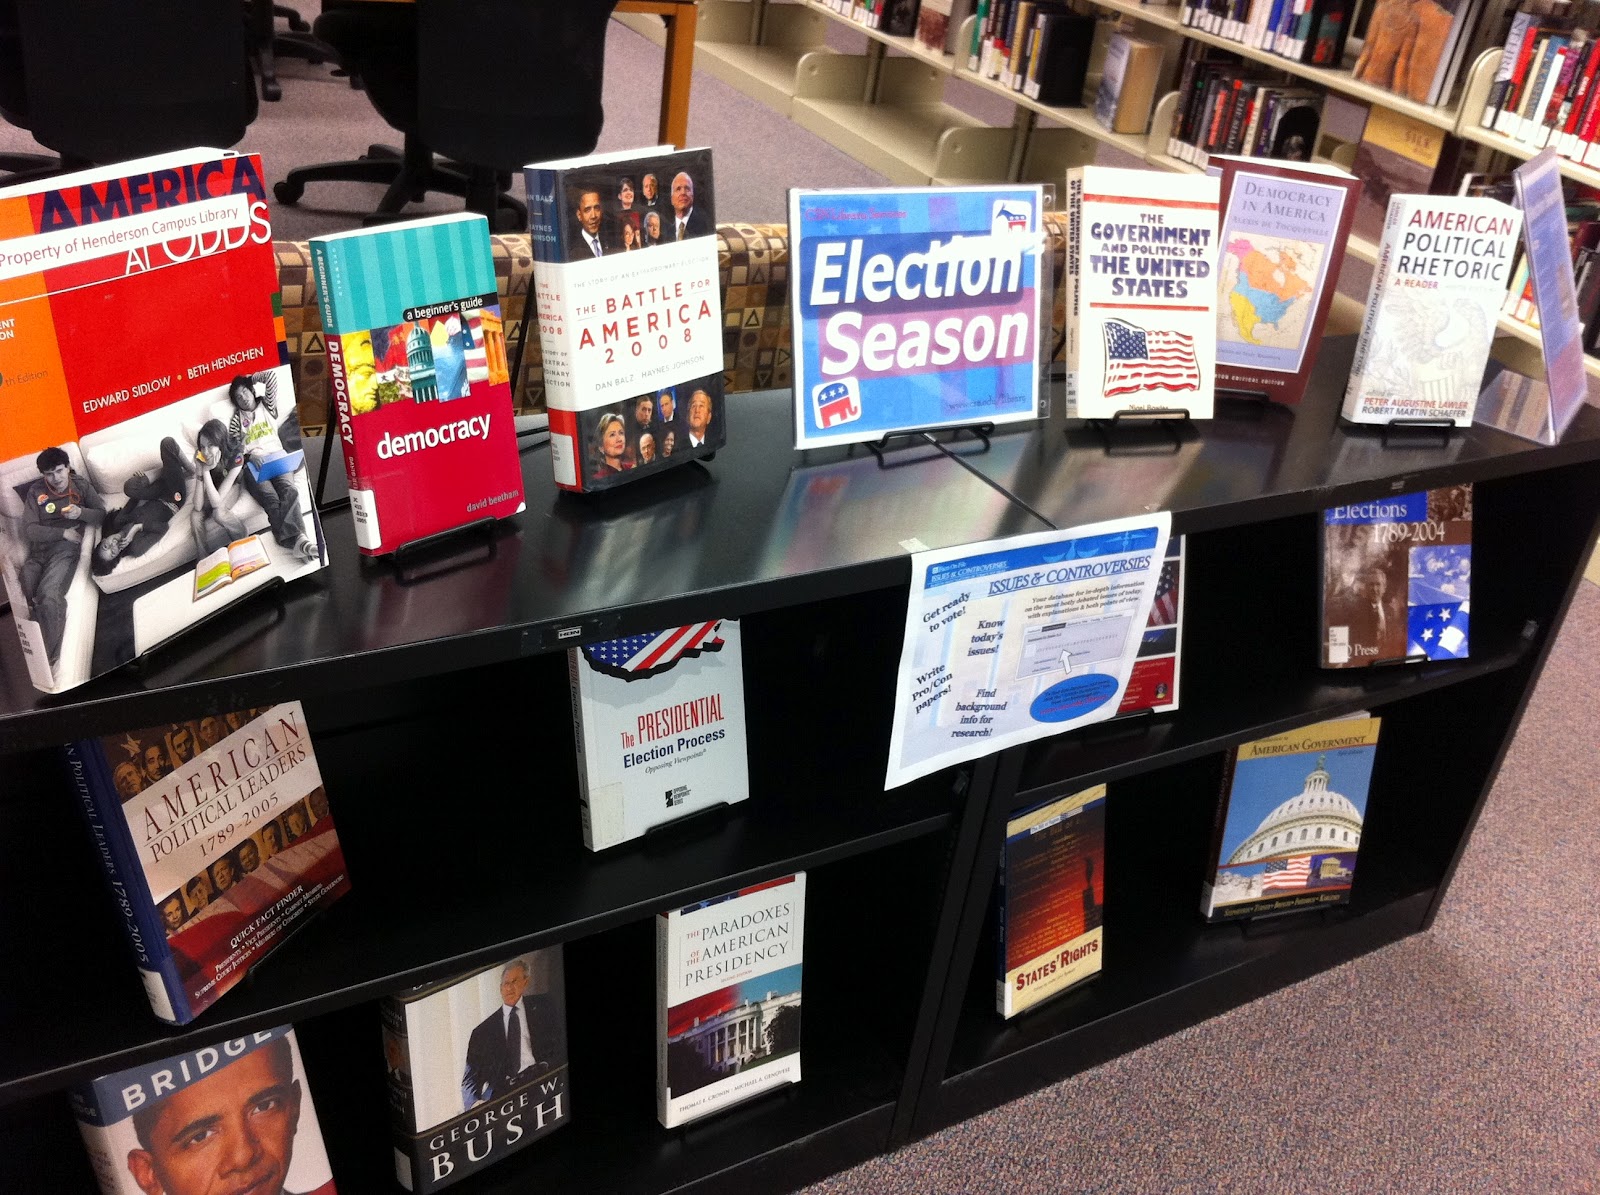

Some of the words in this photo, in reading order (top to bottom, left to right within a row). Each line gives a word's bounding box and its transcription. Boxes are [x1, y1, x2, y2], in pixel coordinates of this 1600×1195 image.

[39, 155, 266, 234] AMERICA
[1244, 182, 1333, 207] DEMOCRACY
[1140, 213, 1164, 225] THE
[1242, 200, 1257, 211] IN
[1261, 201, 1326, 222] AMERICA
[1408, 209, 1513, 236] AMERICAN
[65, 237, 78, 254] of
[82, 227, 149, 251] Henderson
[152, 216, 197, 236] Campus
[199, 206, 239, 224] Library
[1090, 222, 1211, 247] GOVERNMENT
[1101, 243, 1128, 254] AND
[1131, 244, 1186, 257] POLITICS
[1189, 247, 1203, 258] OF
[1402, 232, 1507, 259] POLITICAL
[809, 238, 1022, 306] Election
[1089, 254, 1130, 276] THE
[1136, 256, 1210, 278] UNITED
[1397, 255, 1504, 281] RHETORIC
[575, 304, 597, 317] THE
[606, 282, 684, 314] BATTLE
[690, 279, 710, 290] FOR
[1111, 277, 1188, 299] STATES
[1394, 279, 1401, 287] A
[1403, 280, 1439, 290] READER
[324, 303, 335, 329] GUIDE
[406, 311, 414, 320] a
[415, 300, 459, 321] beginner's
[460, 297, 483, 314] guide
[578, 299, 712, 350] AMERICA
[604, 328, 692, 365] 2008
[821, 311, 1029, 376] Season
[187, 363, 210, 379] BETH
[211, 347, 264, 371] HENSCHEN
[595, 379, 614, 391] DAN
[615, 375, 635, 388] BALZ
[641, 364, 670, 379] HAYNES
[672, 354, 705, 373] JOHNSON
[17, 370, 48, 384] Edition
[83, 391, 130, 414] EDWARD
[131, 376, 171, 400] SIDLOW
[328, 341, 354, 445] DEMOCRACY
[1364, 397, 1389, 406] PETER
[1391, 399, 1437, 409] AUGUSTINE
[1438, 401, 1468, 410] LAWLER
[1361, 406, 1394, 415] ROBERT
[1396, 407, 1427, 417] MARTIN
[1428, 409, 1467, 418] SCHAEFER
[376, 413, 492, 461] democracy
[466, 498, 488, 514] david
[488, 488, 519, 509] beetham
[1334, 500, 1408, 519] Elections
[1373, 521, 1446, 544] 1789-2004
[988, 575, 1031, 595] ISSUES
[1030, 571, 1046, 586] &
[1046, 555, 1152, 583] CONTROVERSIES
[1032, 596, 1047, 604] Your
[1048, 592, 1075, 601] database
[1085, 585, 1110, 595] in-depth
[1110, 581, 1145, 591] information
[1033, 603, 1044, 611] the
[1044, 602, 1060, 610] most
[1060, 599, 1075, 608] hotly
[1076, 595, 1099, 604] debated
[1099, 592, 1117, 600] issues
[922, 607, 941, 623] Get
[942, 592, 971, 612] ready
[929, 623, 940, 633] to
[941, 605, 967, 625] vote!
[1027, 612, 1041, 620] with
[1041, 606, 1080, 618] explanations
[1086, 601, 1099, 610] both
[1100, 599, 1119, 609] points
[559, 628, 581, 638] HON
[970, 631, 1003, 644] today's
[977, 619, 1005, 630] Know
[967, 644, 1000, 657] issues!
[1354, 644, 1379, 657] Press
[911, 673, 953, 703] Pro/Con
[916, 664, 946, 685] Write
[915, 684, 952, 715] papers!
[976, 688, 998, 698] Find
[955, 701, 1008, 713] background
[959, 714, 979, 725] info
[978, 714, 994, 724] for
[620, 732, 635, 750] The
[636, 693, 725, 745] PRESIDENTIAL
[951, 727, 993, 738] research!
[623, 743, 674, 769] Election
[677, 728, 726, 754] Process
[1249, 742, 1300, 757] AMERICAN
[1302, 735, 1367, 750] GOVERNMENT
[144, 710, 302, 841] AMERICAN
[645, 761, 673, 774] Opposing
[150, 799, 238, 863] POLITICAL
[240, 743, 308, 809] LEADERS
[200, 792, 279, 857] 1789-2005
[69, 760, 98, 820] POLITICAL
[91, 823, 117, 875] LEADERS
[112, 879, 150, 963] 1789-2005
[230, 921, 256, 949] QUICK
[255, 906, 276, 928] FACT
[276, 885, 304, 911] FINDER
[686, 930, 700, 940] THE
[701, 902, 791, 942] PARADOXES
[194, 977, 217, 999] SUPREME
[215, 963, 233, 982] COURT
[231, 949, 253, 970] JUSTICES
[255, 929, 277, 951] MEMBERS
[307, 894, 321, 910] STATE
[215, 948, 242, 973] PRESIDENTS
[244, 936, 258, 948] VICE
[256, 916, 281, 939] PRESIDENTS
[686, 957, 700, 967] THE
[700, 922, 789, 962] AMERICAN
[690, 949, 700, 958] OF
[684, 940, 789, 987] PRESIDENCY
[1015, 954, 1060, 991] STATES'
[1060, 939, 1099, 970] RIGHTS
[679, 1100, 701, 1113] THOMAS
[707, 1089, 730, 1101] CRONIN
[734, 1078, 757, 1091] MICHAEL
[763, 1067, 791, 1080] GENOVESE
[429, 1091, 529, 1151] GEORGE
[540, 1076, 565, 1095] W.
[428, 1092, 566, 1183] BUSH
